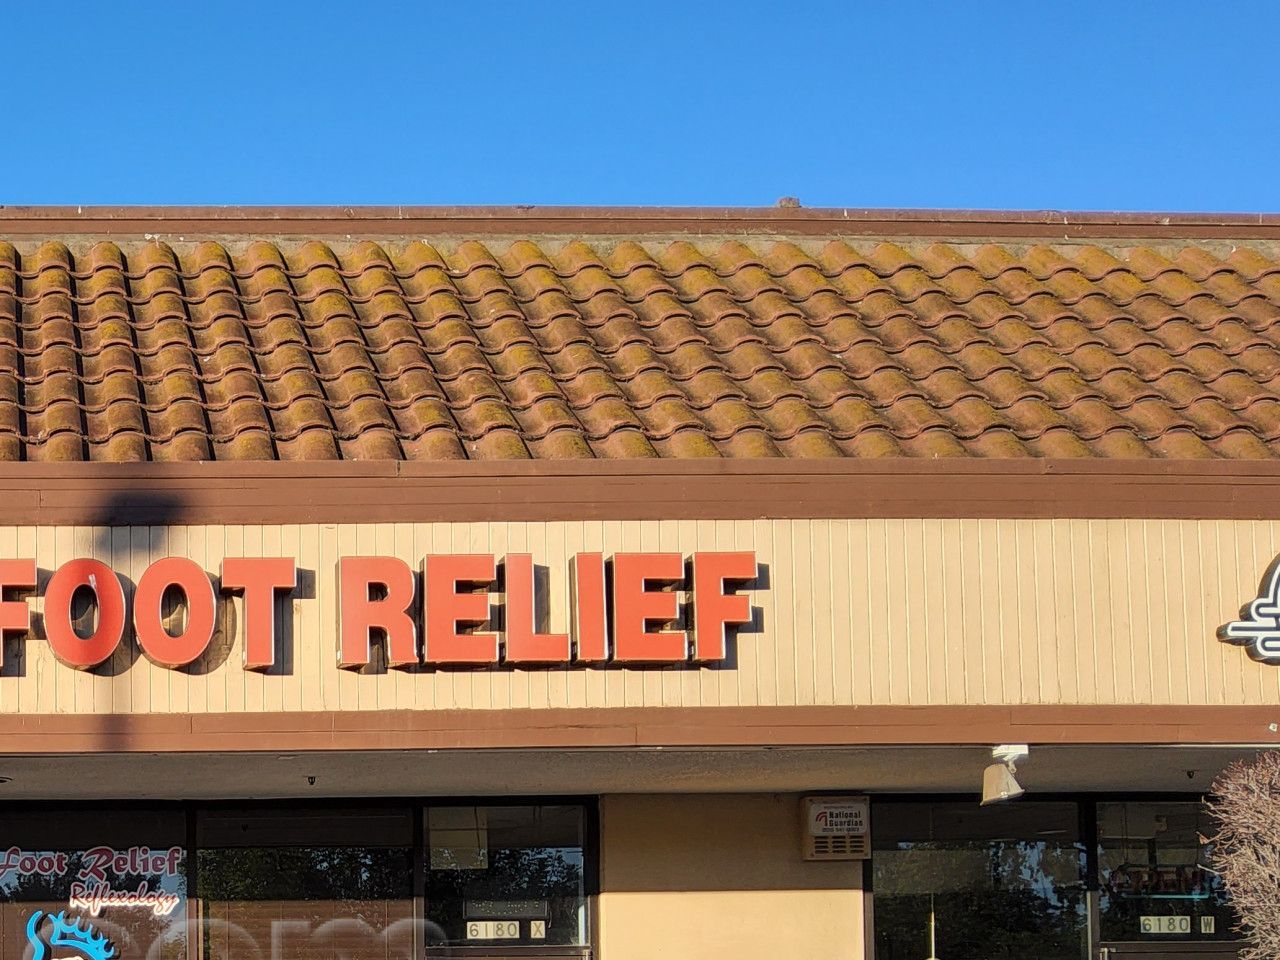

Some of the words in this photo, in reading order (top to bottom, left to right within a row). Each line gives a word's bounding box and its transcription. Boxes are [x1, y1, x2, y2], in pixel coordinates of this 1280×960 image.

[336, 551, 758, 669] RELIEF
[78, 845, 183, 883] Relief
[70, 881, 180, 916] Reflexology
[469, 923, 517, 937] 6180
[533, 922, 543, 937] X
[1142, 917, 1189, 931] 6180
[1203, 917, 1212, 931] W
